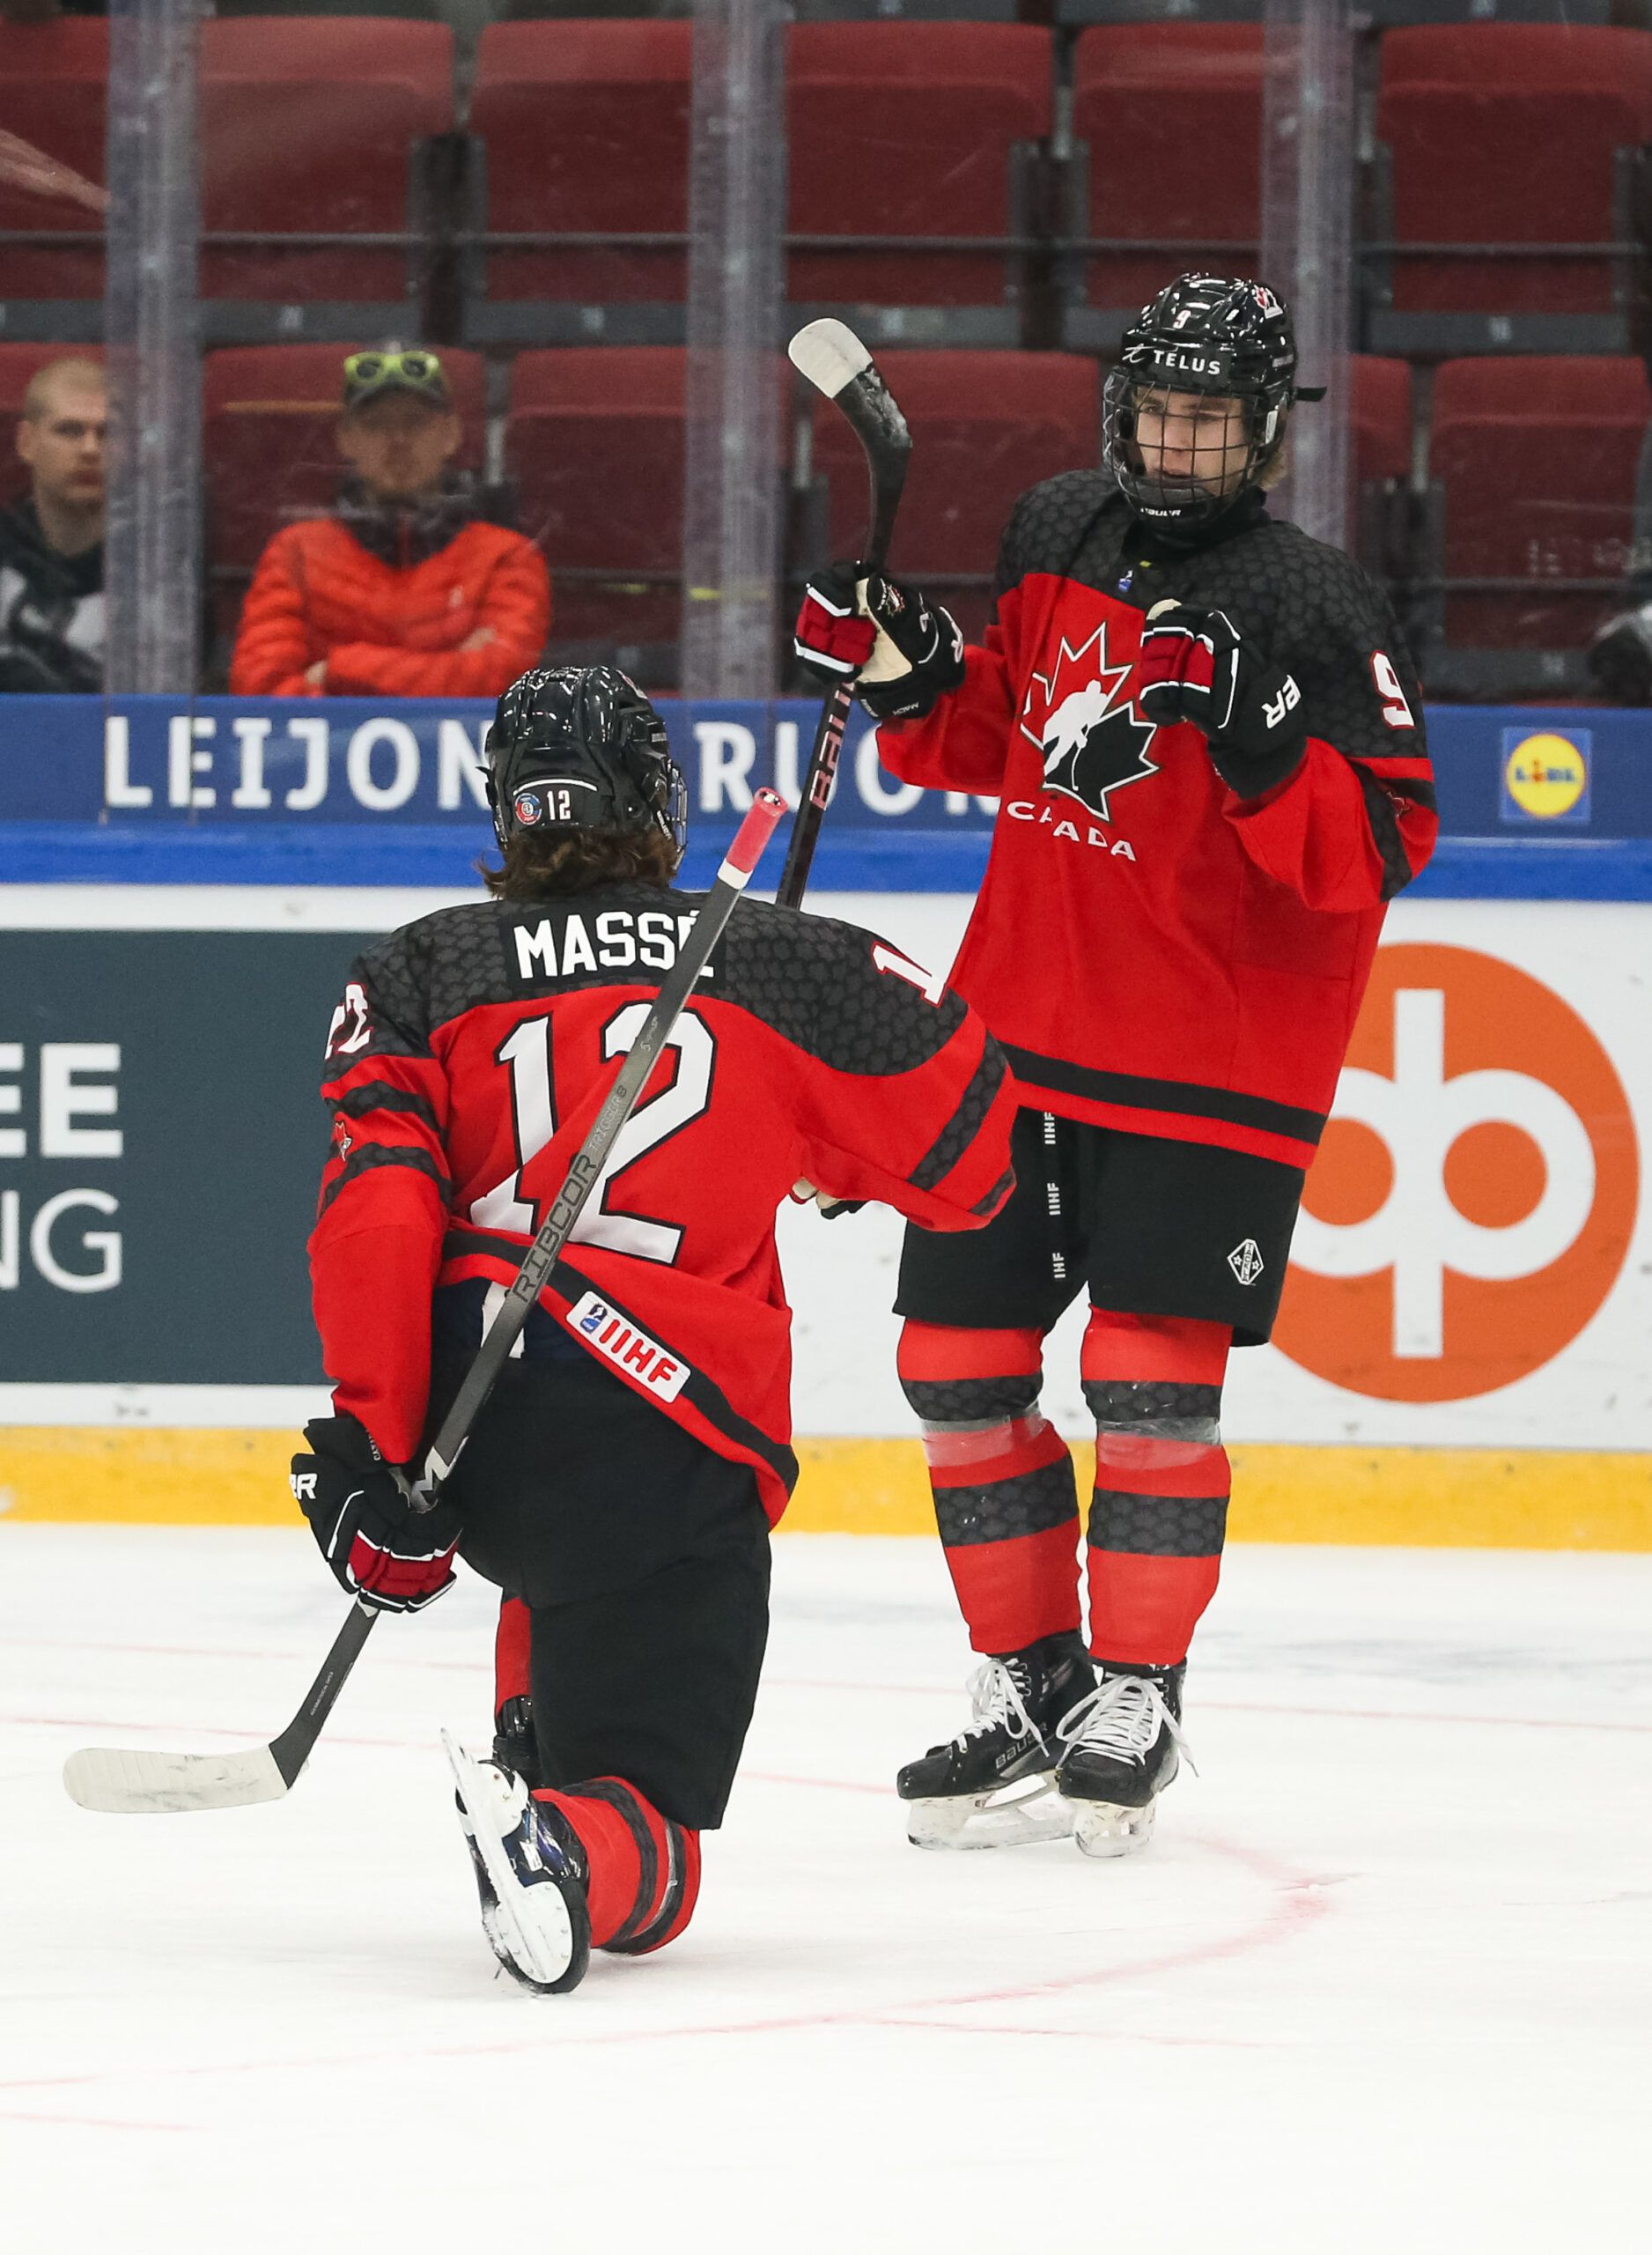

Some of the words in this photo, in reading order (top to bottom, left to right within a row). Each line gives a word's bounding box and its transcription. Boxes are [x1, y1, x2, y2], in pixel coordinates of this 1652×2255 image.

[1173, 309, 1191, 330] 9
[1153, 349, 1221, 375] TELUS
[1369, 650, 1415, 729] 9
[546, 789, 572, 821] 12
[1007, 801, 1137, 862] CAADA
[469, 999, 719, 1266] 12
[1044, 1111, 1056, 1144] IIHF
[1047, 1182, 1061, 1216] IIHF
[513, 1155, 596, 1304] RIBCOR
[599, 1319, 678, 1383] IIHF
